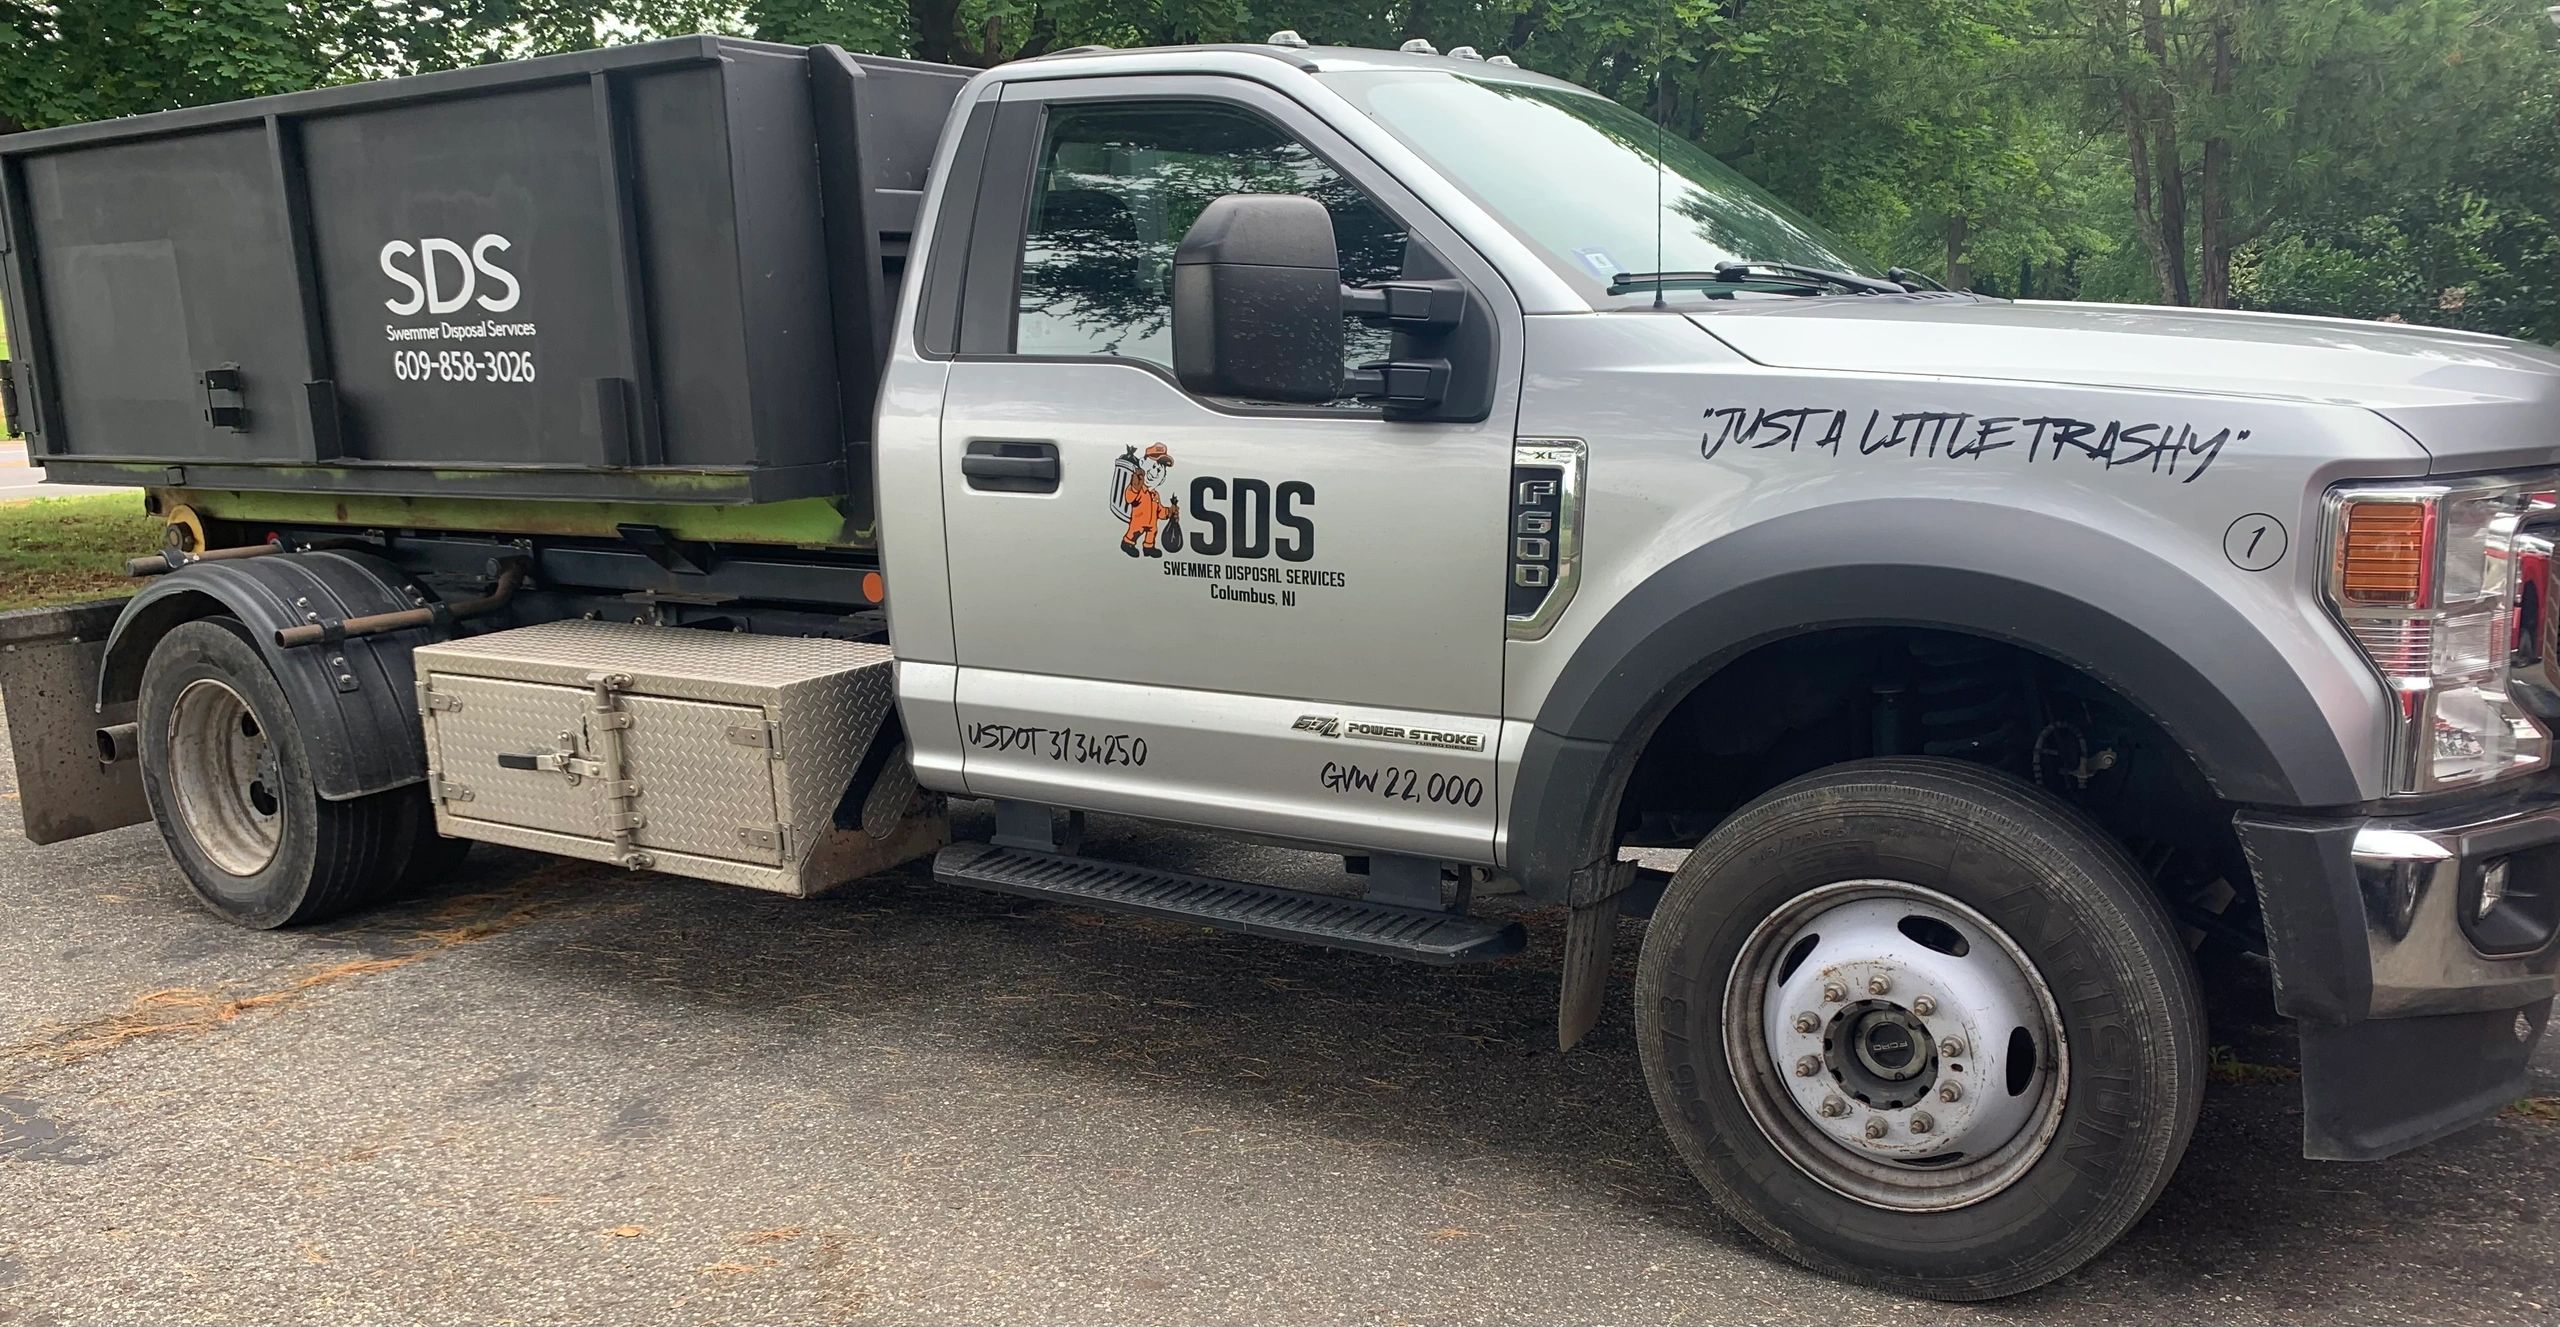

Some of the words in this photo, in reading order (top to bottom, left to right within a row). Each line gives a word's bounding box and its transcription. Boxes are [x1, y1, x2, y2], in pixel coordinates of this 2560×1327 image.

[380, 233, 521, 316] SDS
[386, 324, 440, 342] Swemmer
[440, 321, 487, 342] Disposal
[487, 319, 537, 338] Services
[394, 350, 537, 383] 609-858-3026
[1535, 451, 1557, 460] XL
[1701, 407, 1835, 460] "JUST
[1816, 408, 1848, 457] A
[1858, 408, 2021, 461] LITTLE
[2022, 415, 2251, 484] TRASHY"
[1189, 475, 1316, 563] SDS
[1514, 480, 1558, 588] F600
[2246, 526, 2266, 560] 1
[1163, 560, 1222, 580] SWEMMER
[1225, 564, 1283, 584] DISPOSAL
[1286, 568, 1346, 588] SERVICES
[1210, 584, 1278, 607] Columbus,
[1281, 590, 1296, 608] NJ
[967, 722, 1049, 756] USDOT
[1048, 726, 1149, 768] 3134250
[1347, 722, 1406, 739] POWER
[1408, 729, 1479, 746] STROKE
[1320, 761, 1379, 794] GVW
[1383, 766, 1484, 808] 22,000
[1872, 1040, 1908, 1051] FORD
